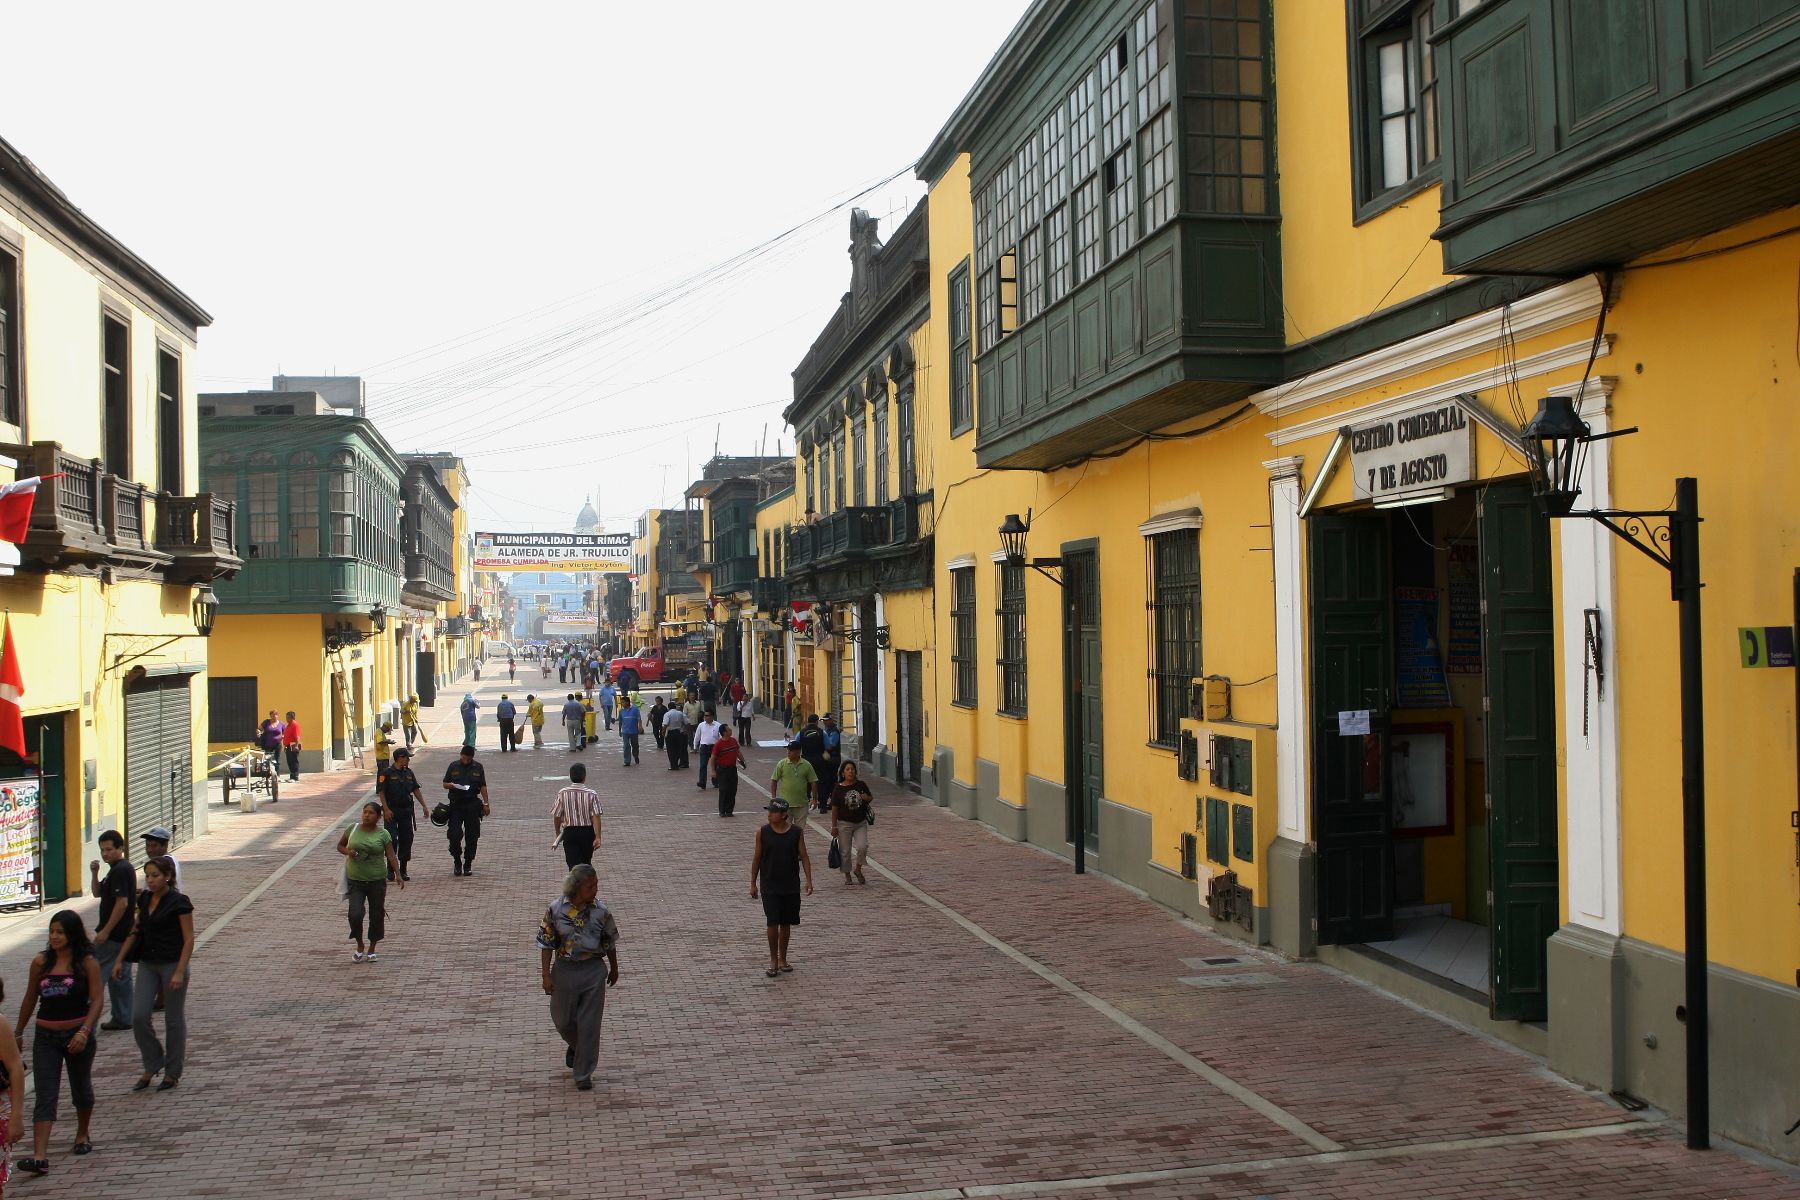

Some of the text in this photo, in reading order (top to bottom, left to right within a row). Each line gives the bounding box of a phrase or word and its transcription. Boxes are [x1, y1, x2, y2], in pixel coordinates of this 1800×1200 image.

[1352, 405, 1466, 454] CENTRO COMERCIAL
[1368, 453, 1447, 492] 7 DE AGOSTO
[497, 535, 573, 545] MUNICIPALIDAD
[576, 536, 595, 545] DEL
[498, 548, 629, 558] ALAMEDA DE JR. TRUJILLO
